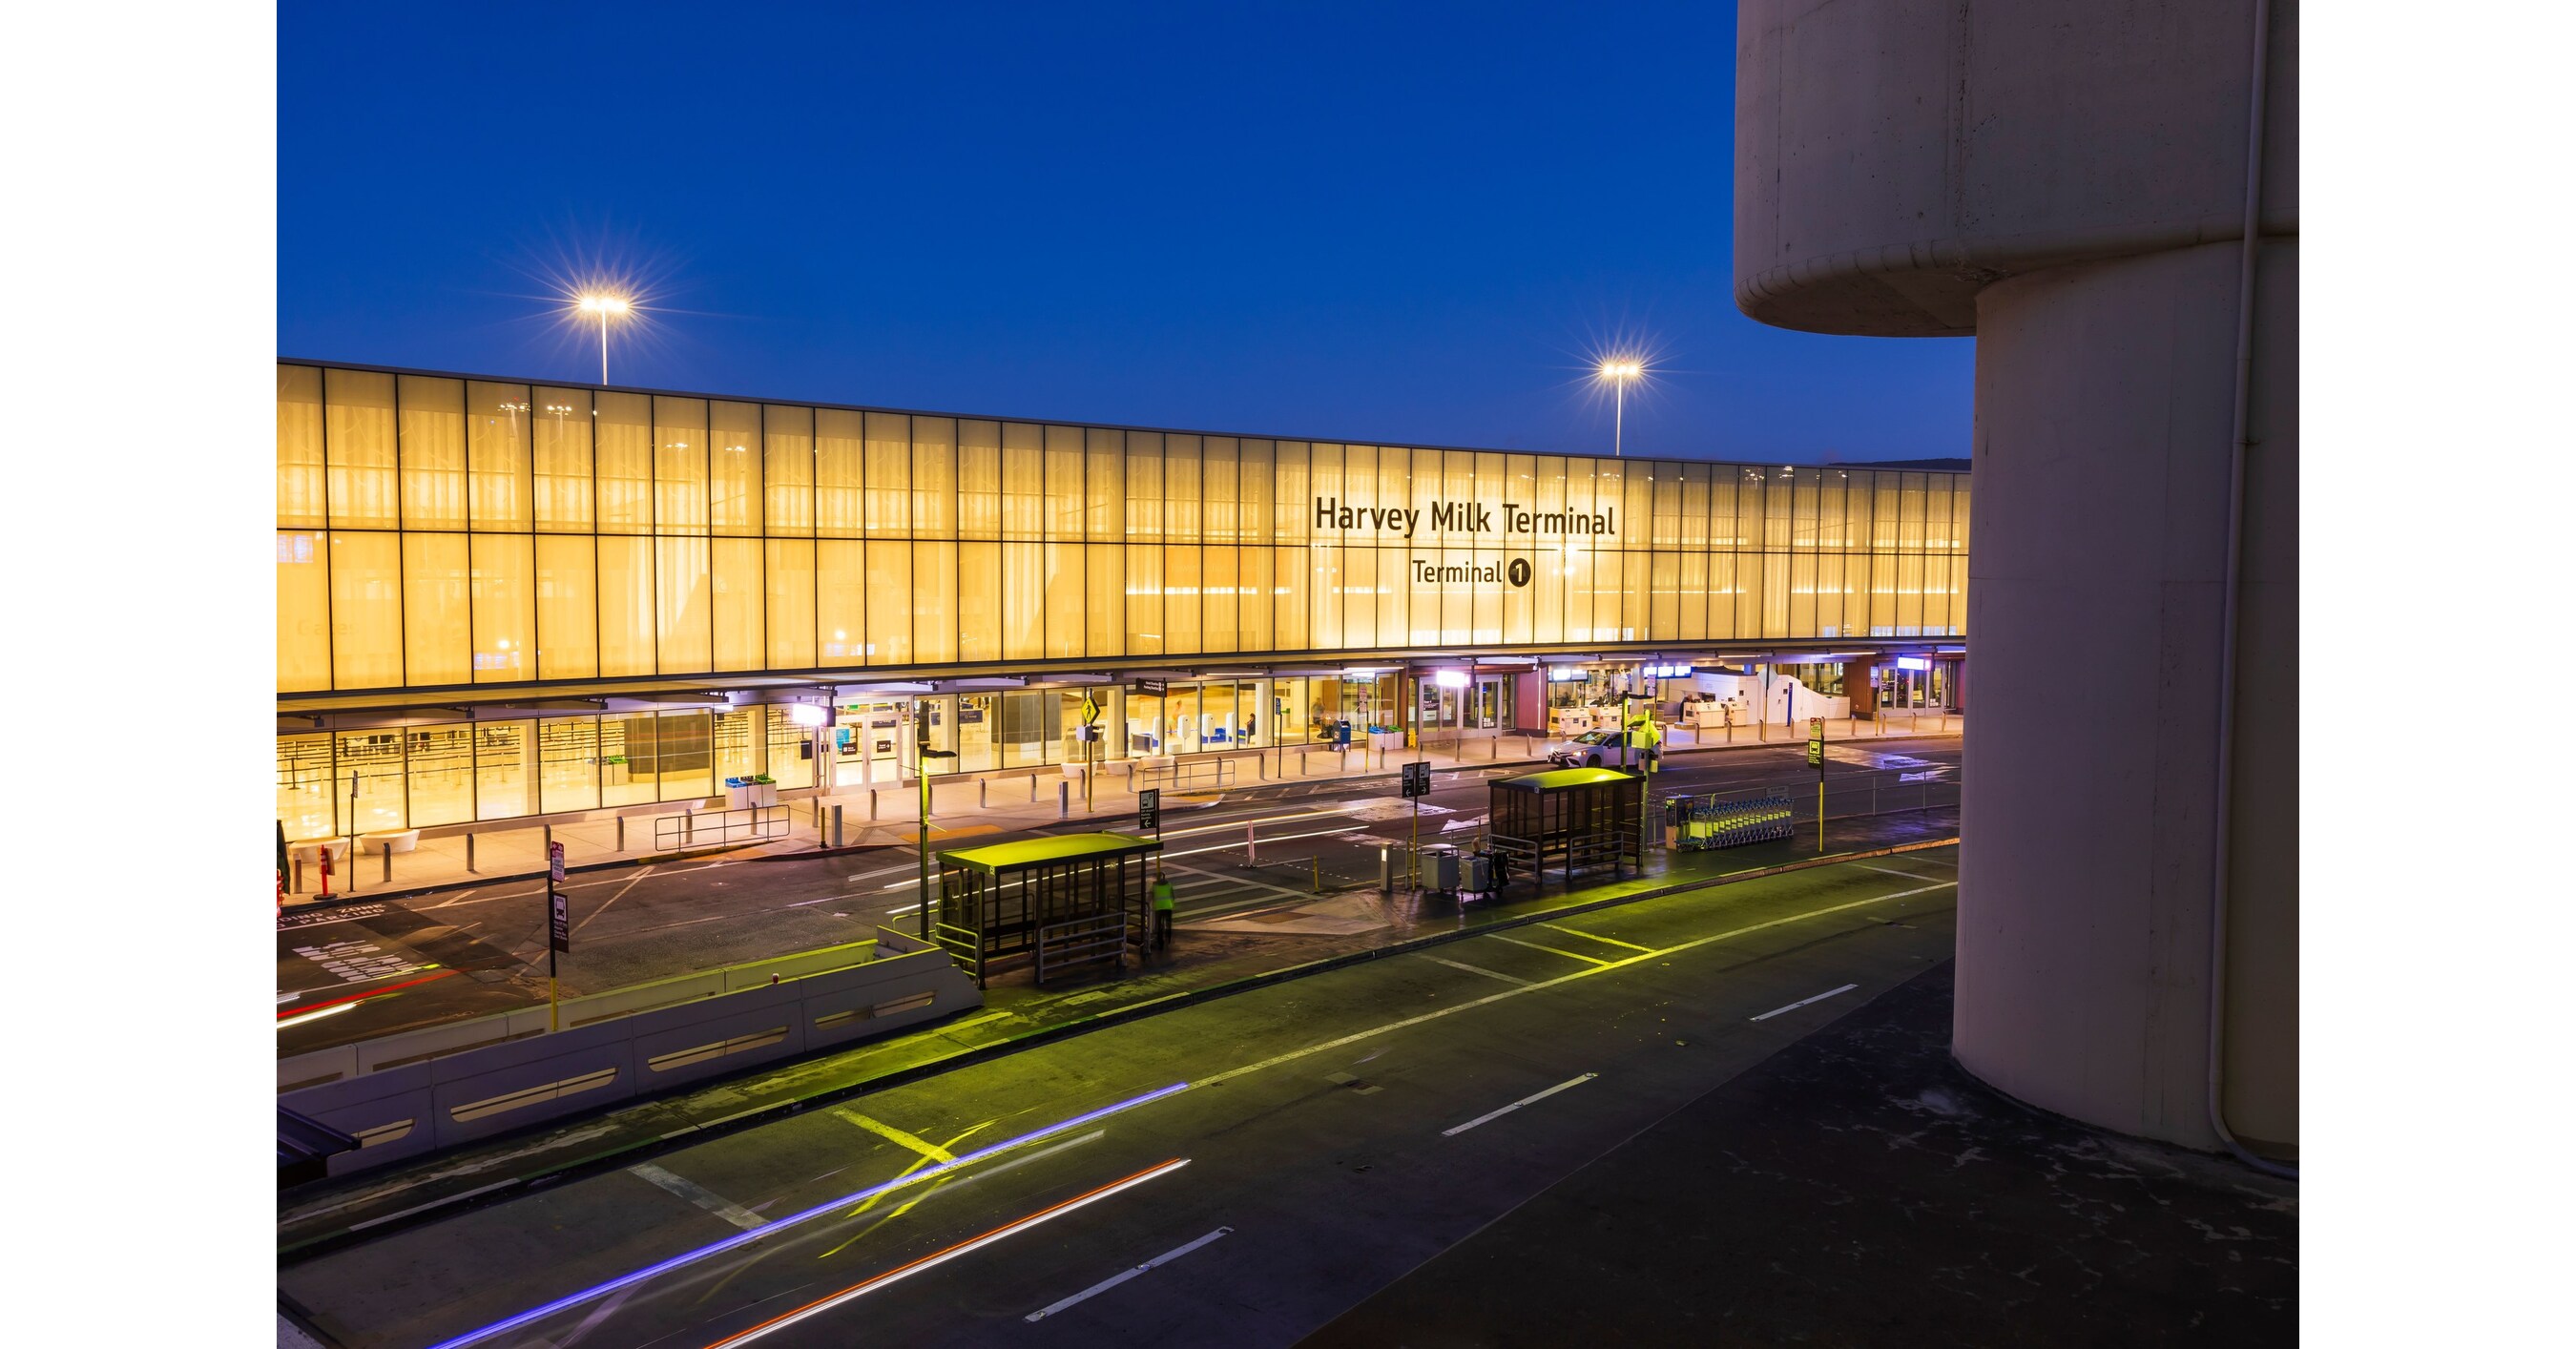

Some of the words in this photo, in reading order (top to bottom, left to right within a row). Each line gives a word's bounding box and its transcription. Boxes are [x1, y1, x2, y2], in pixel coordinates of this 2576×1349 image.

[1316, 496, 1420, 539] Harvey
[1431, 501, 1491, 532] Milk
[1503, 504, 1615, 535] Terminal
[1412, 560, 1502, 583] Terminal
[299, 908, 384, 924] PARKING
[336, 904, 385, 913] ZONE
